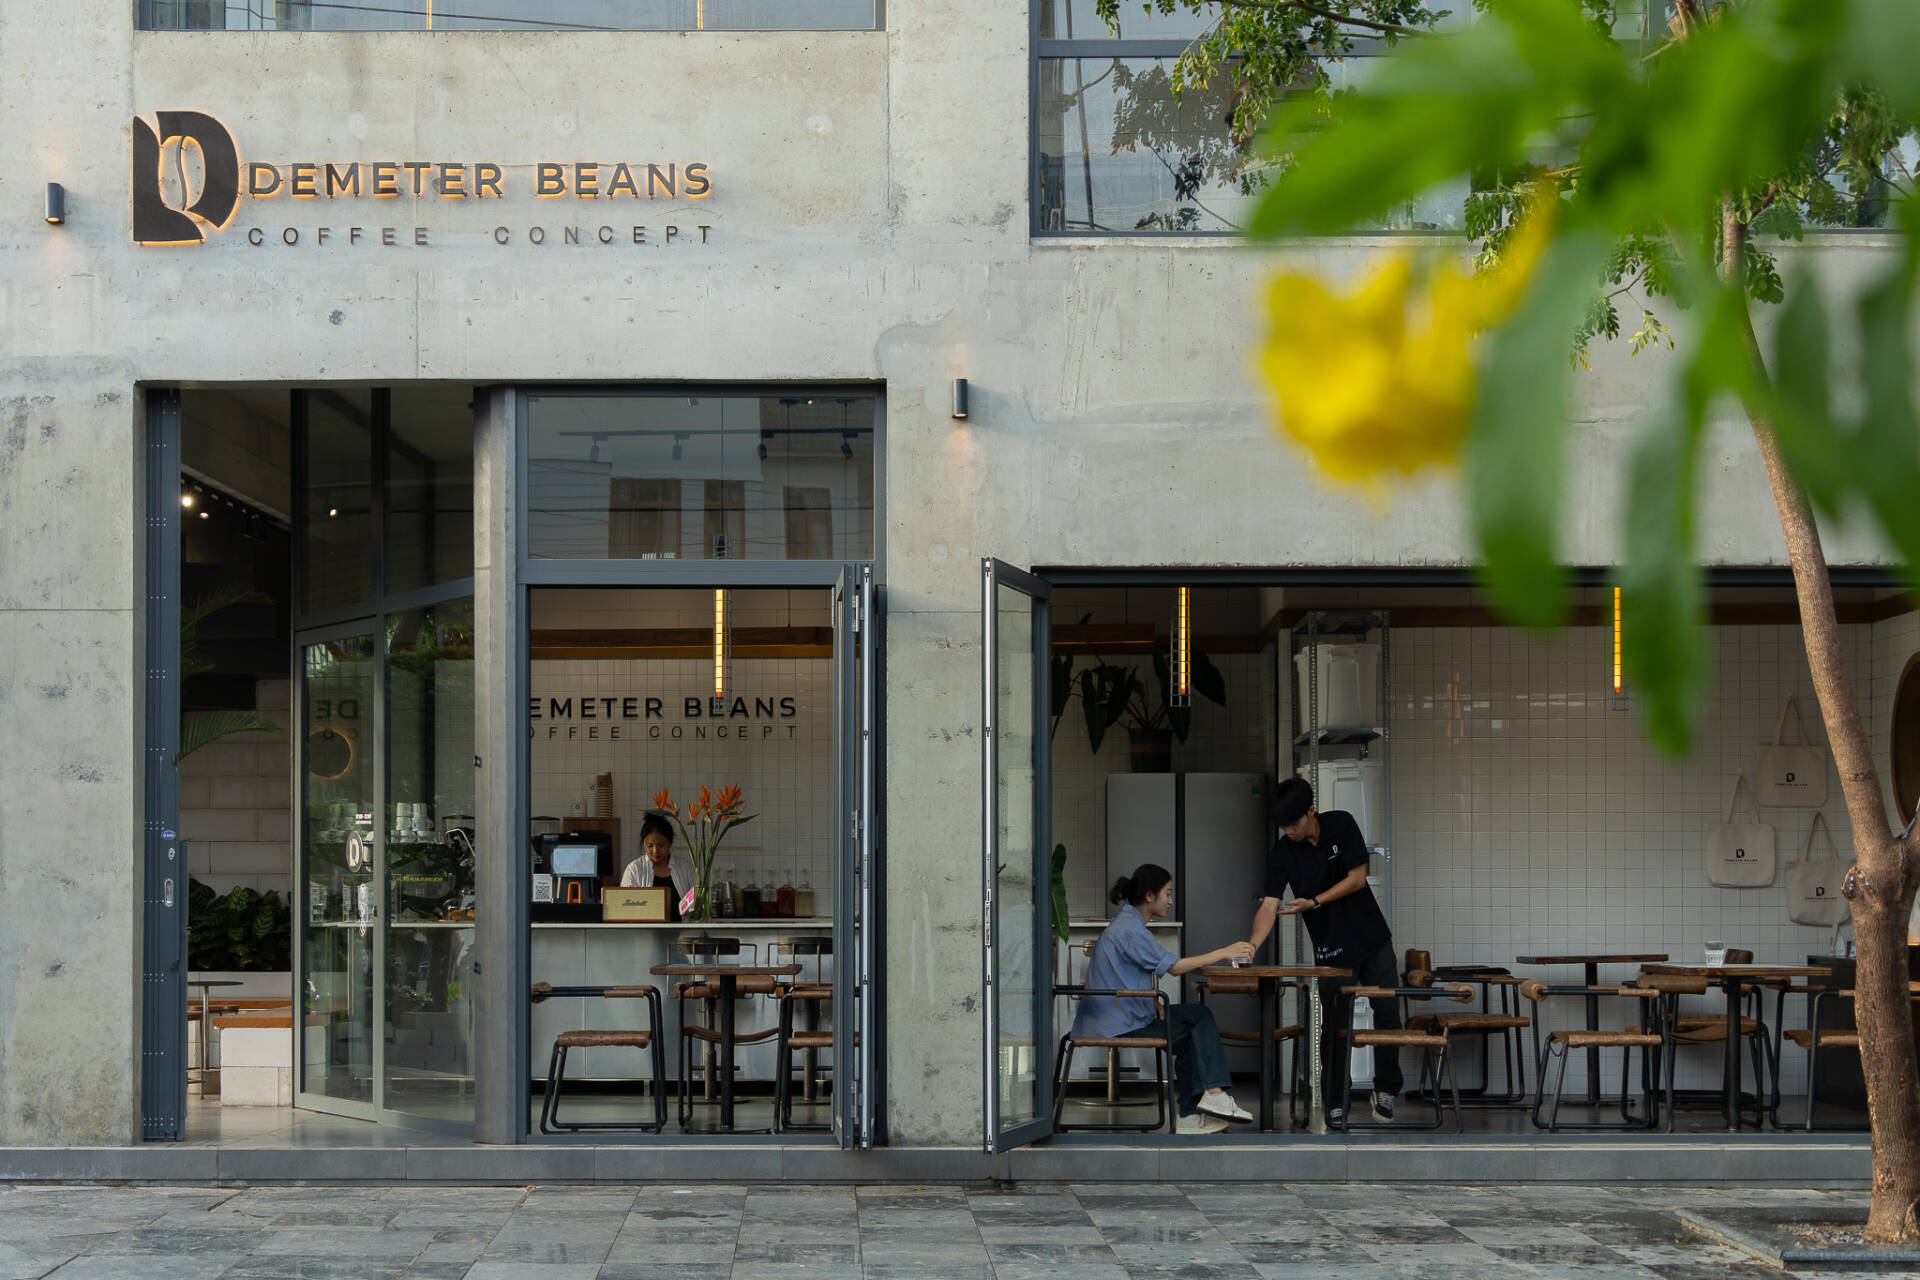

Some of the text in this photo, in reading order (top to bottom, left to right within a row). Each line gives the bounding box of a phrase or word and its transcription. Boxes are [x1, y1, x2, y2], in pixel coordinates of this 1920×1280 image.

[248, 161, 710, 196] DEMETER BEANS
[247, 225, 711, 246] COFFEE CONCEPT
[530, 696, 797, 719] EMETER BEANS
[649, 725, 797, 740] CONCEPT
